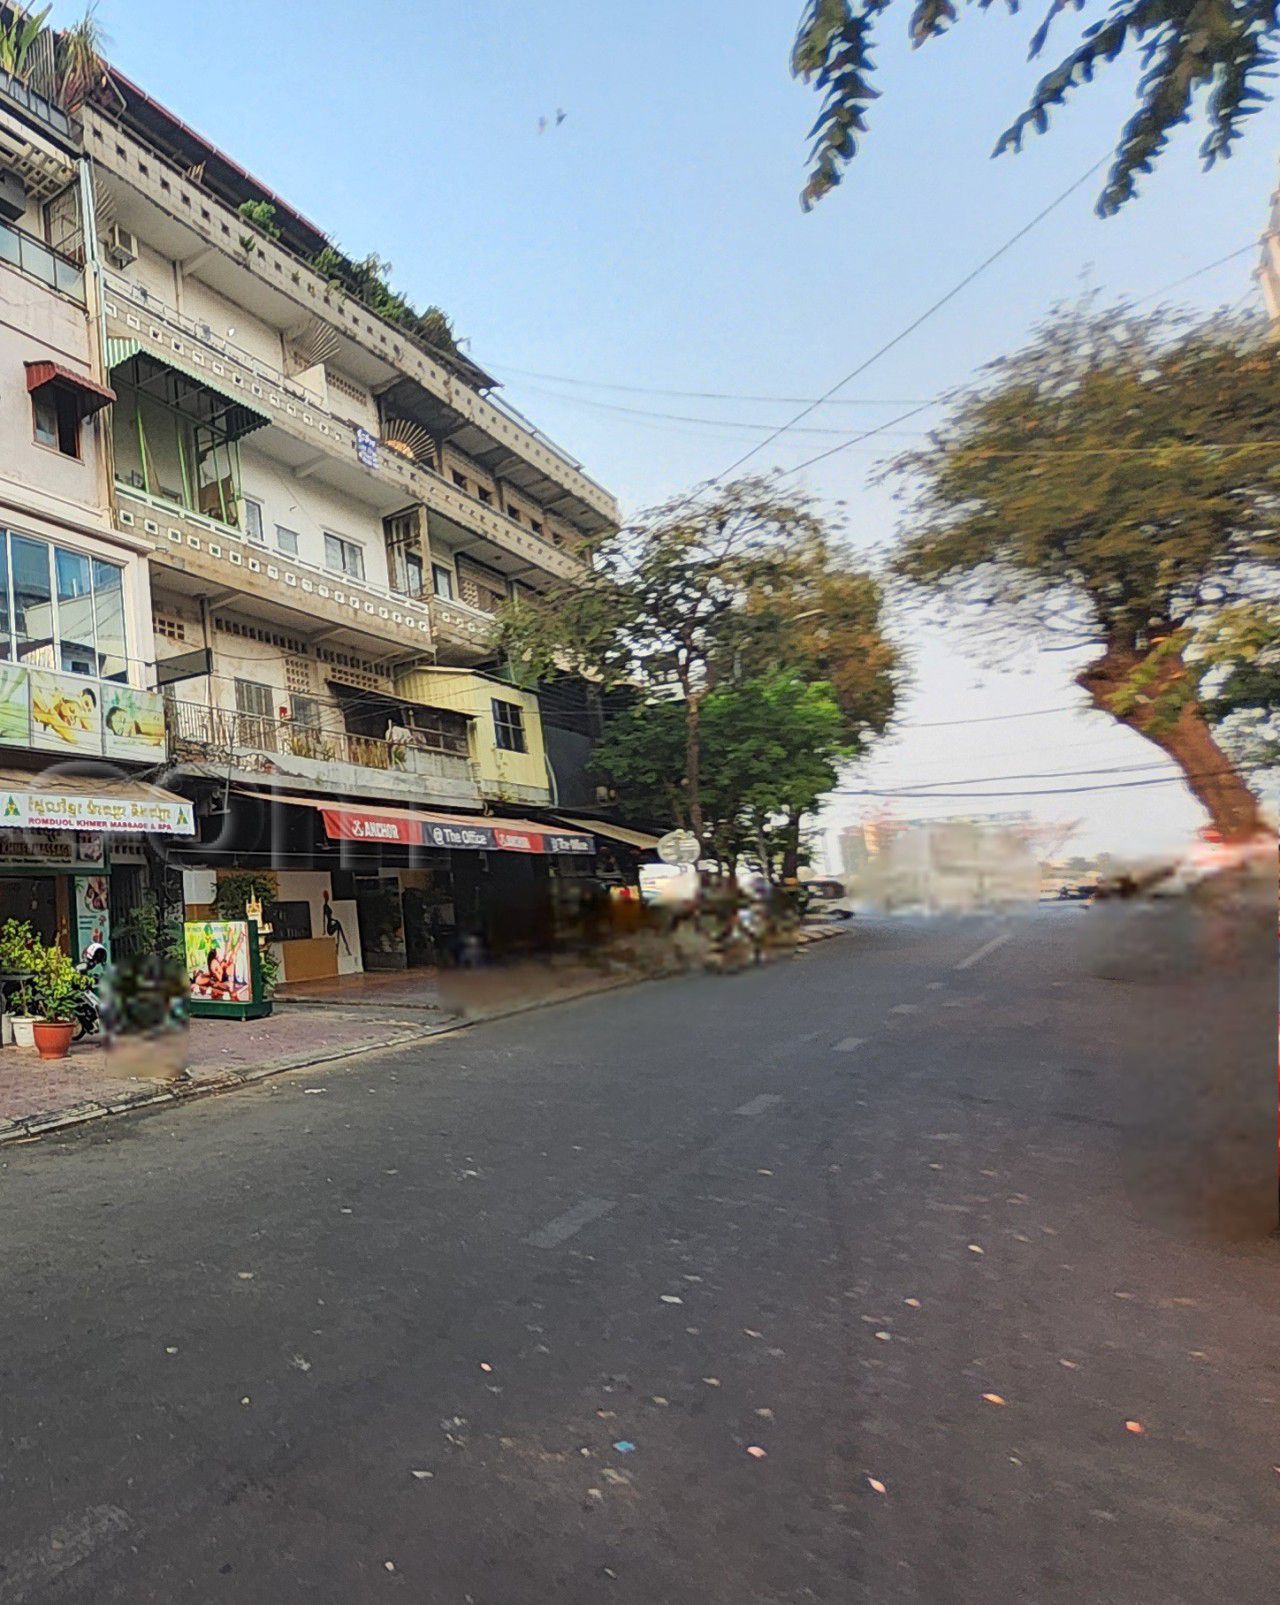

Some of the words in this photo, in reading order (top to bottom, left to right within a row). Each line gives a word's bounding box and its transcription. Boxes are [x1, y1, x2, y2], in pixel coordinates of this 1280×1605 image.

[28, 817, 75, 827] ROMDUOL
[76, 819, 107, 828] KHMER
[443, 829, 461, 842] The
